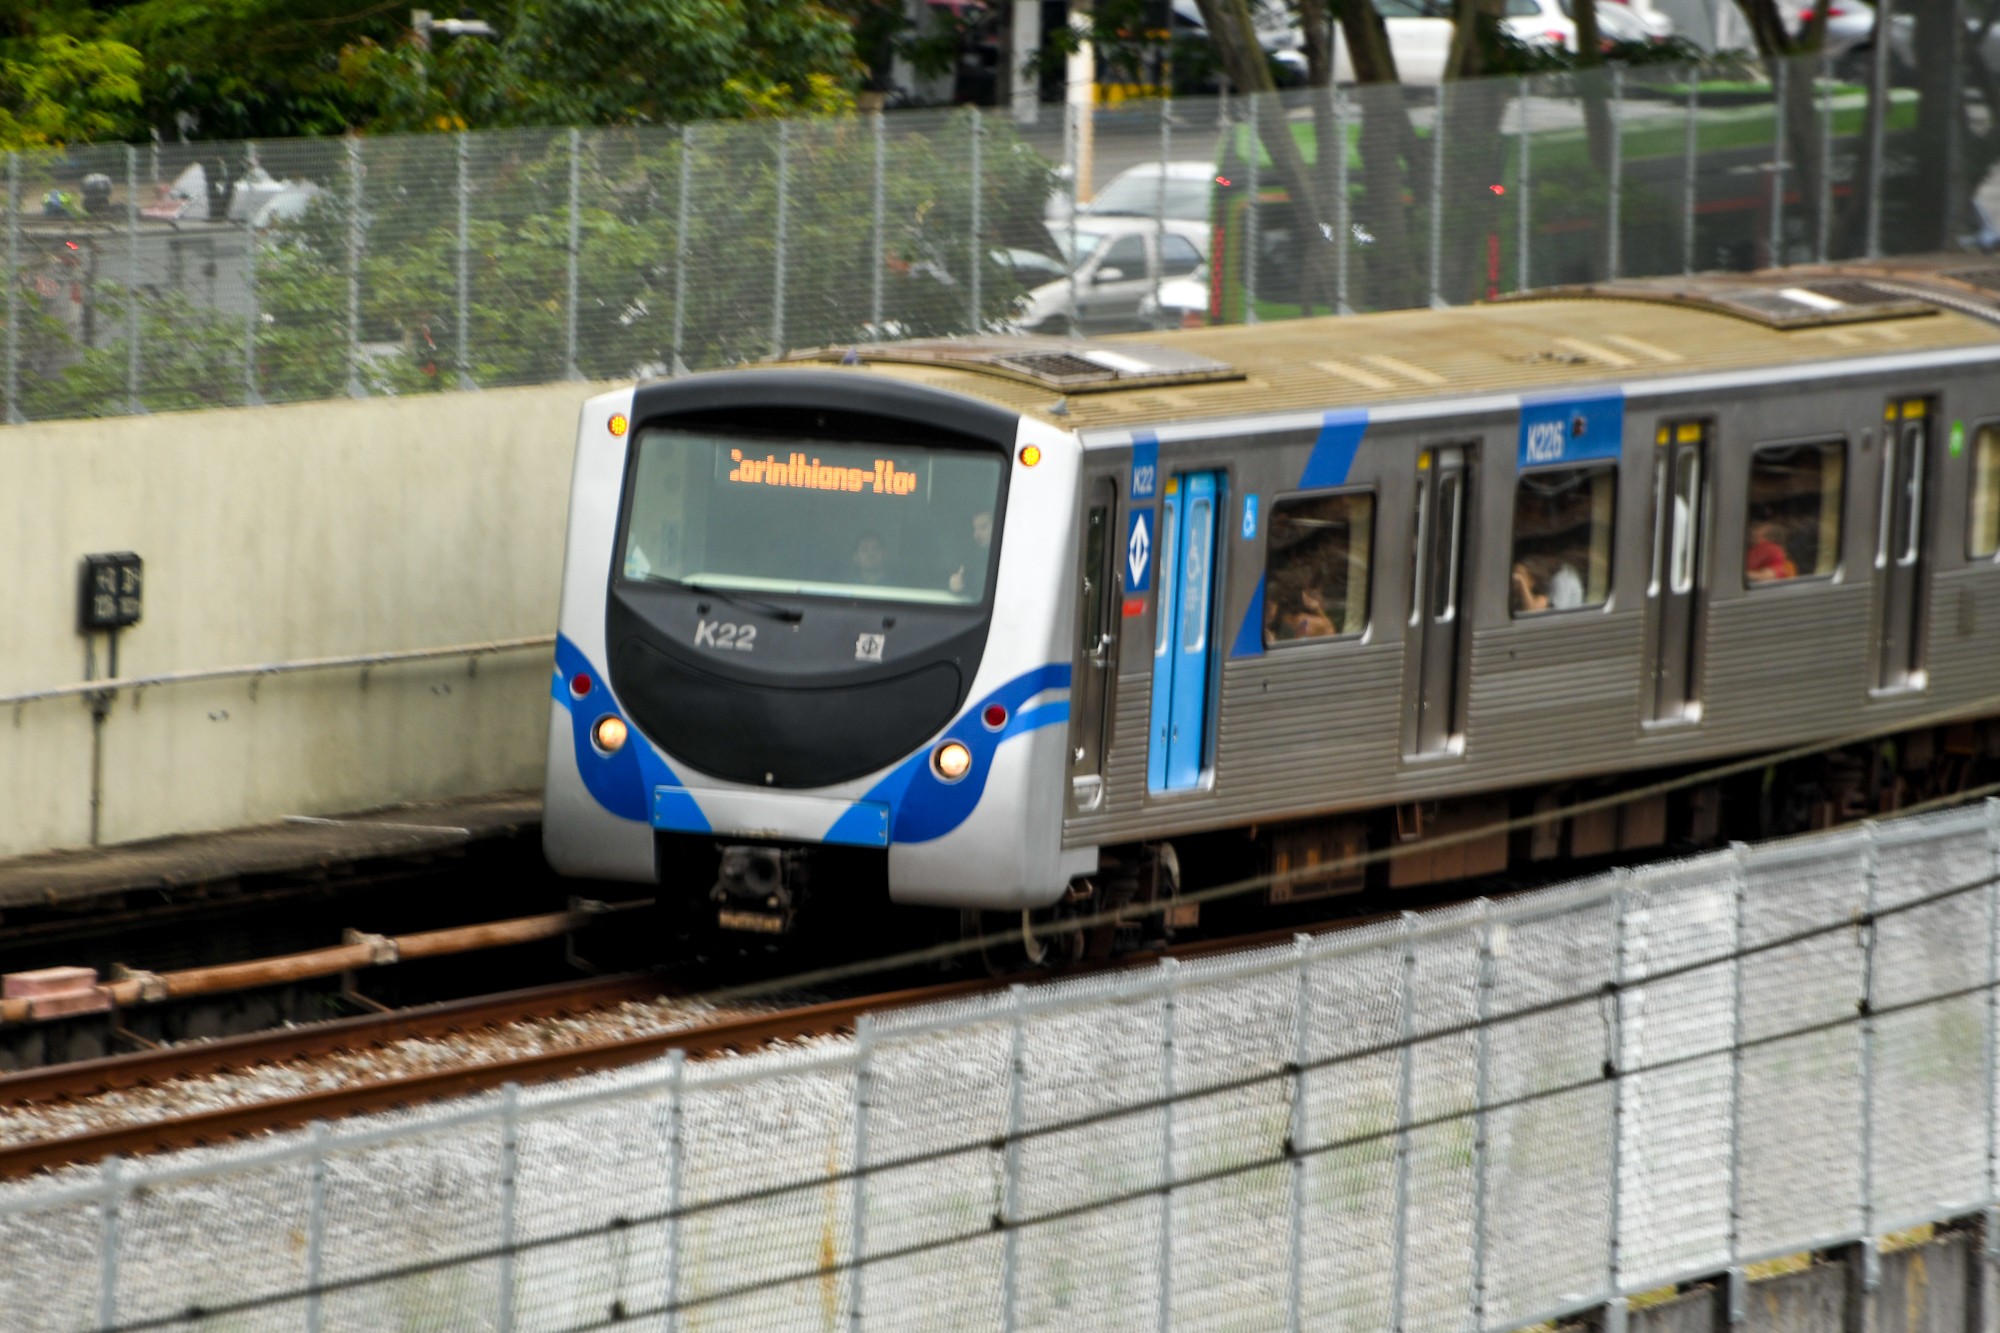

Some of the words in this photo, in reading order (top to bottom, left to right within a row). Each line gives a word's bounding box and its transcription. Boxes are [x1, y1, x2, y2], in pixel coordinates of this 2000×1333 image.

[1527, 421, 1564, 463] K226
[1133, 464, 1155, 496] K22
[693, 619, 757, 652] K22
